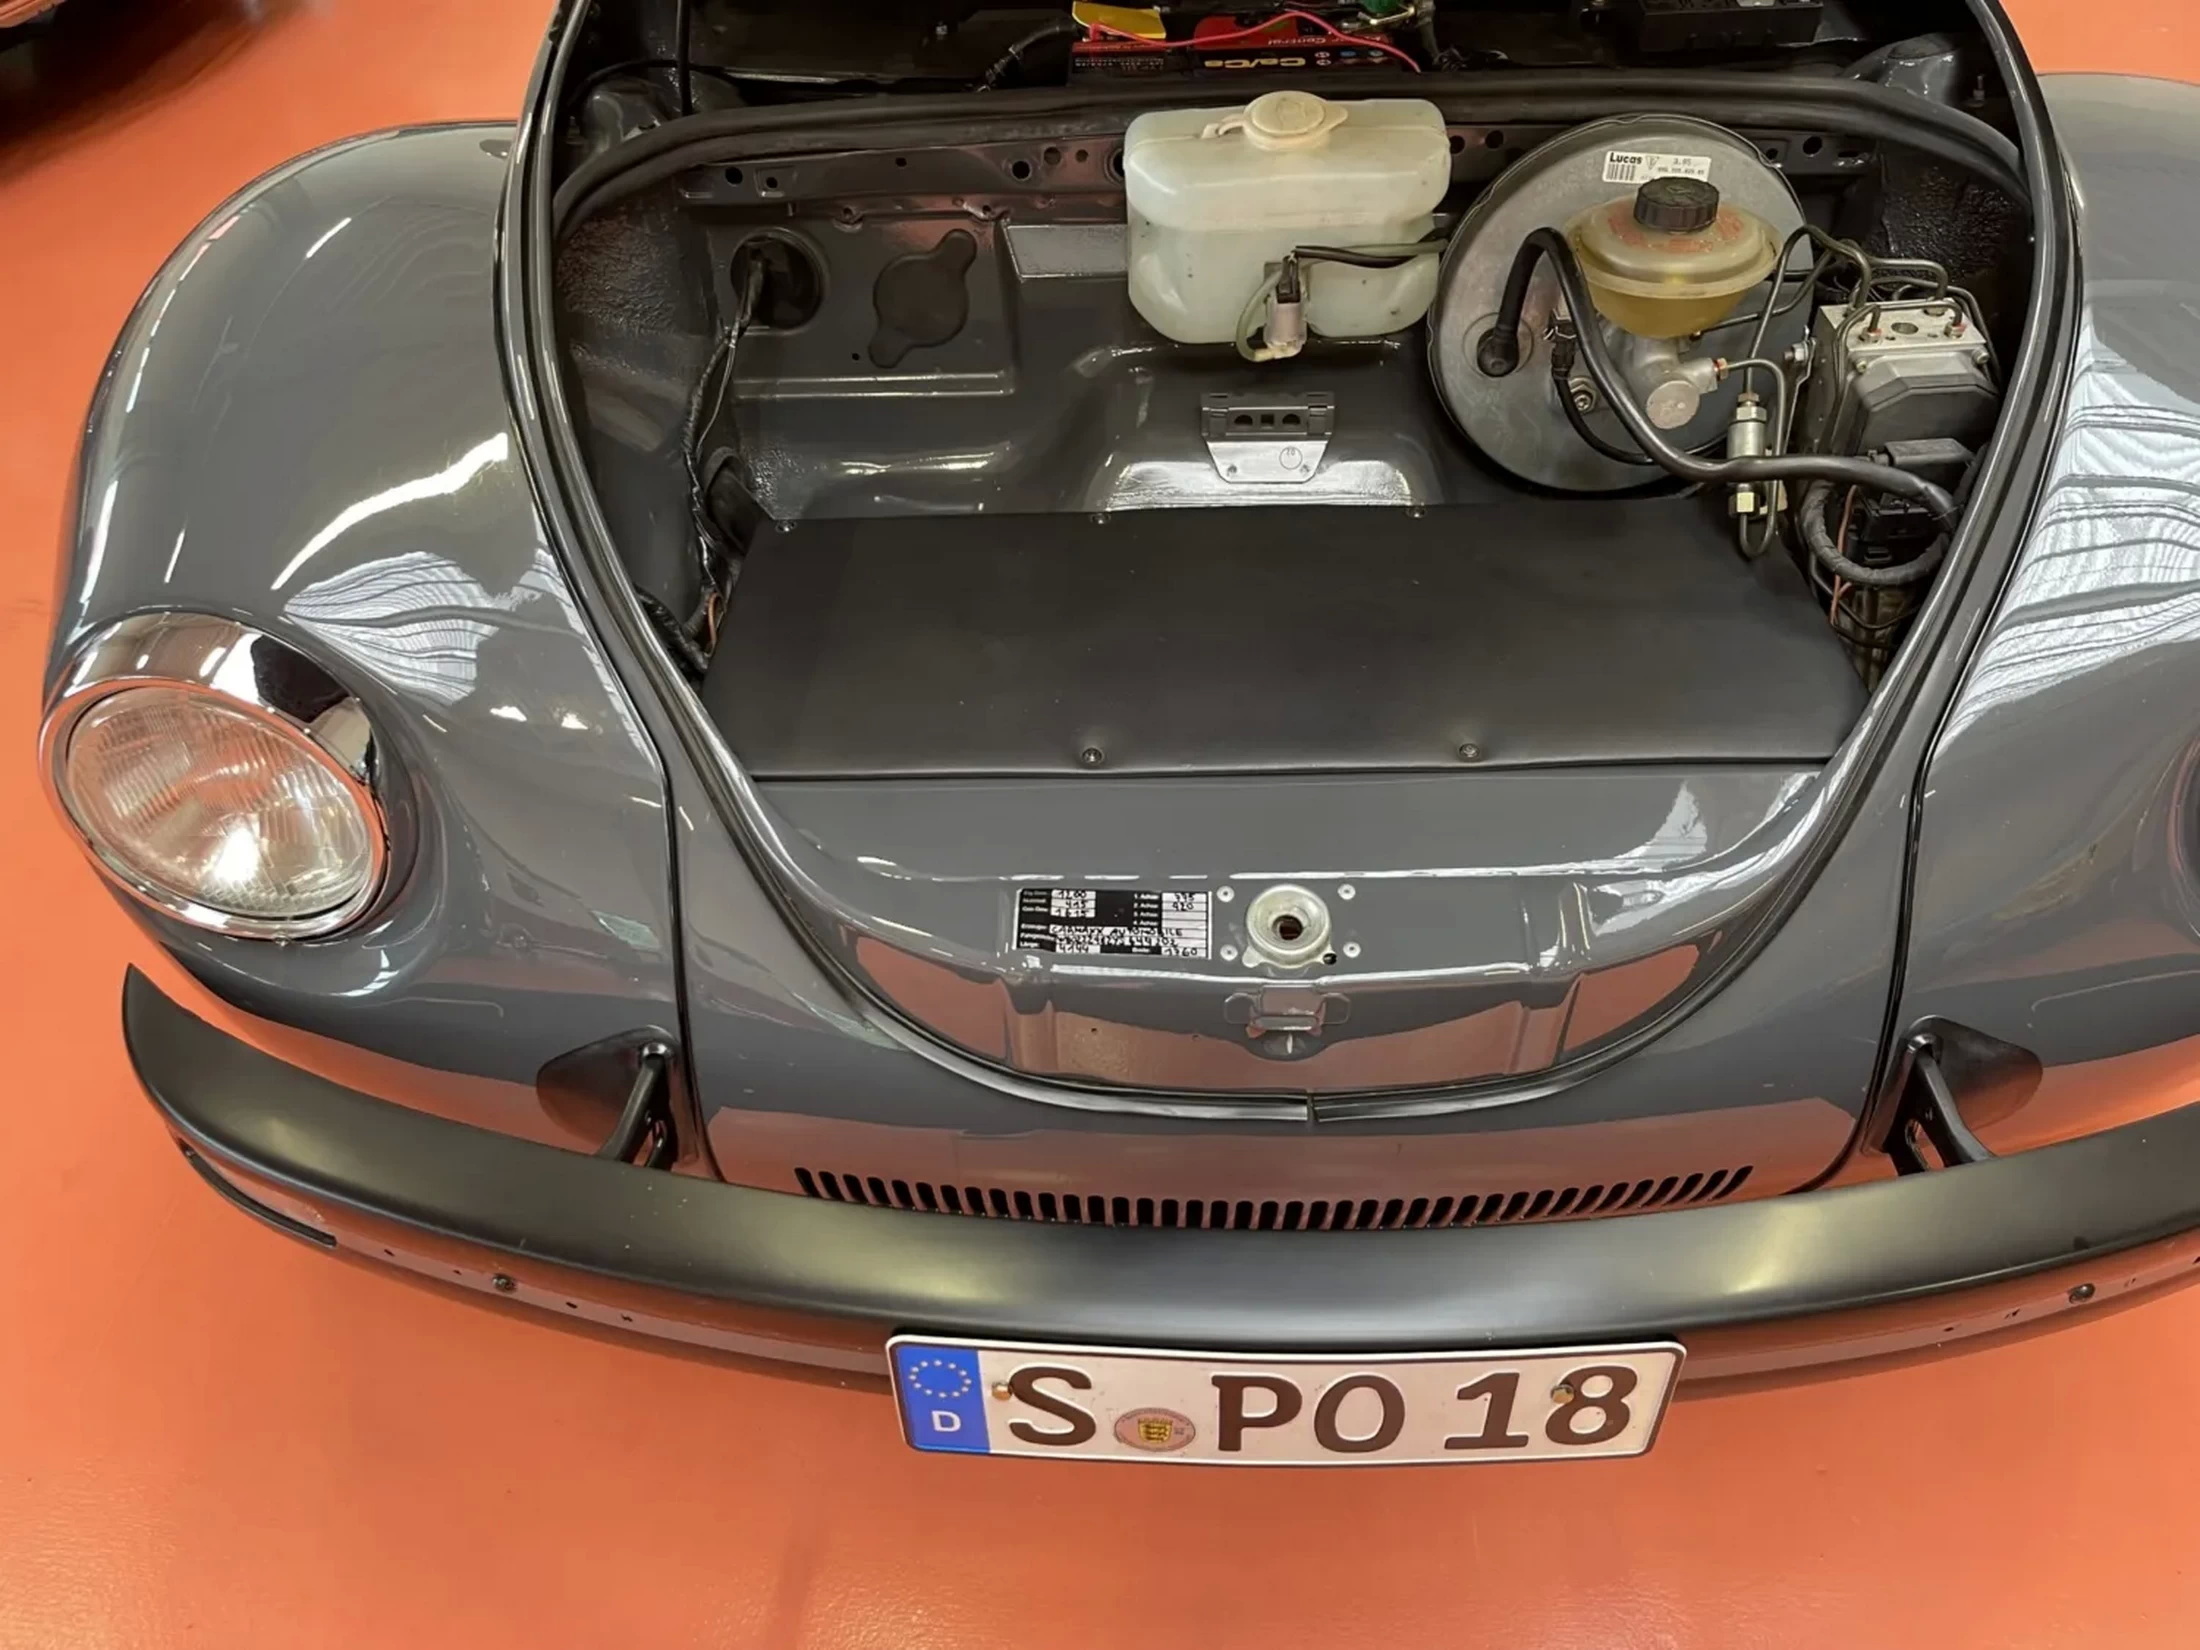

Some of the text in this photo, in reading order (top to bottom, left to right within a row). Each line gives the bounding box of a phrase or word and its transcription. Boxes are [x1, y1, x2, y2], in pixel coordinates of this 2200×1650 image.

[1204, 57, 1306, 69] Ca/Ca
[1609, 152, 1643, 164] Lucas
[1008, 1366, 1097, 1446] S
[1211, 1374, 1406, 1453] PO
[1444, 1365, 1638, 1450] 18
[931, 1410, 962, 1432] D
